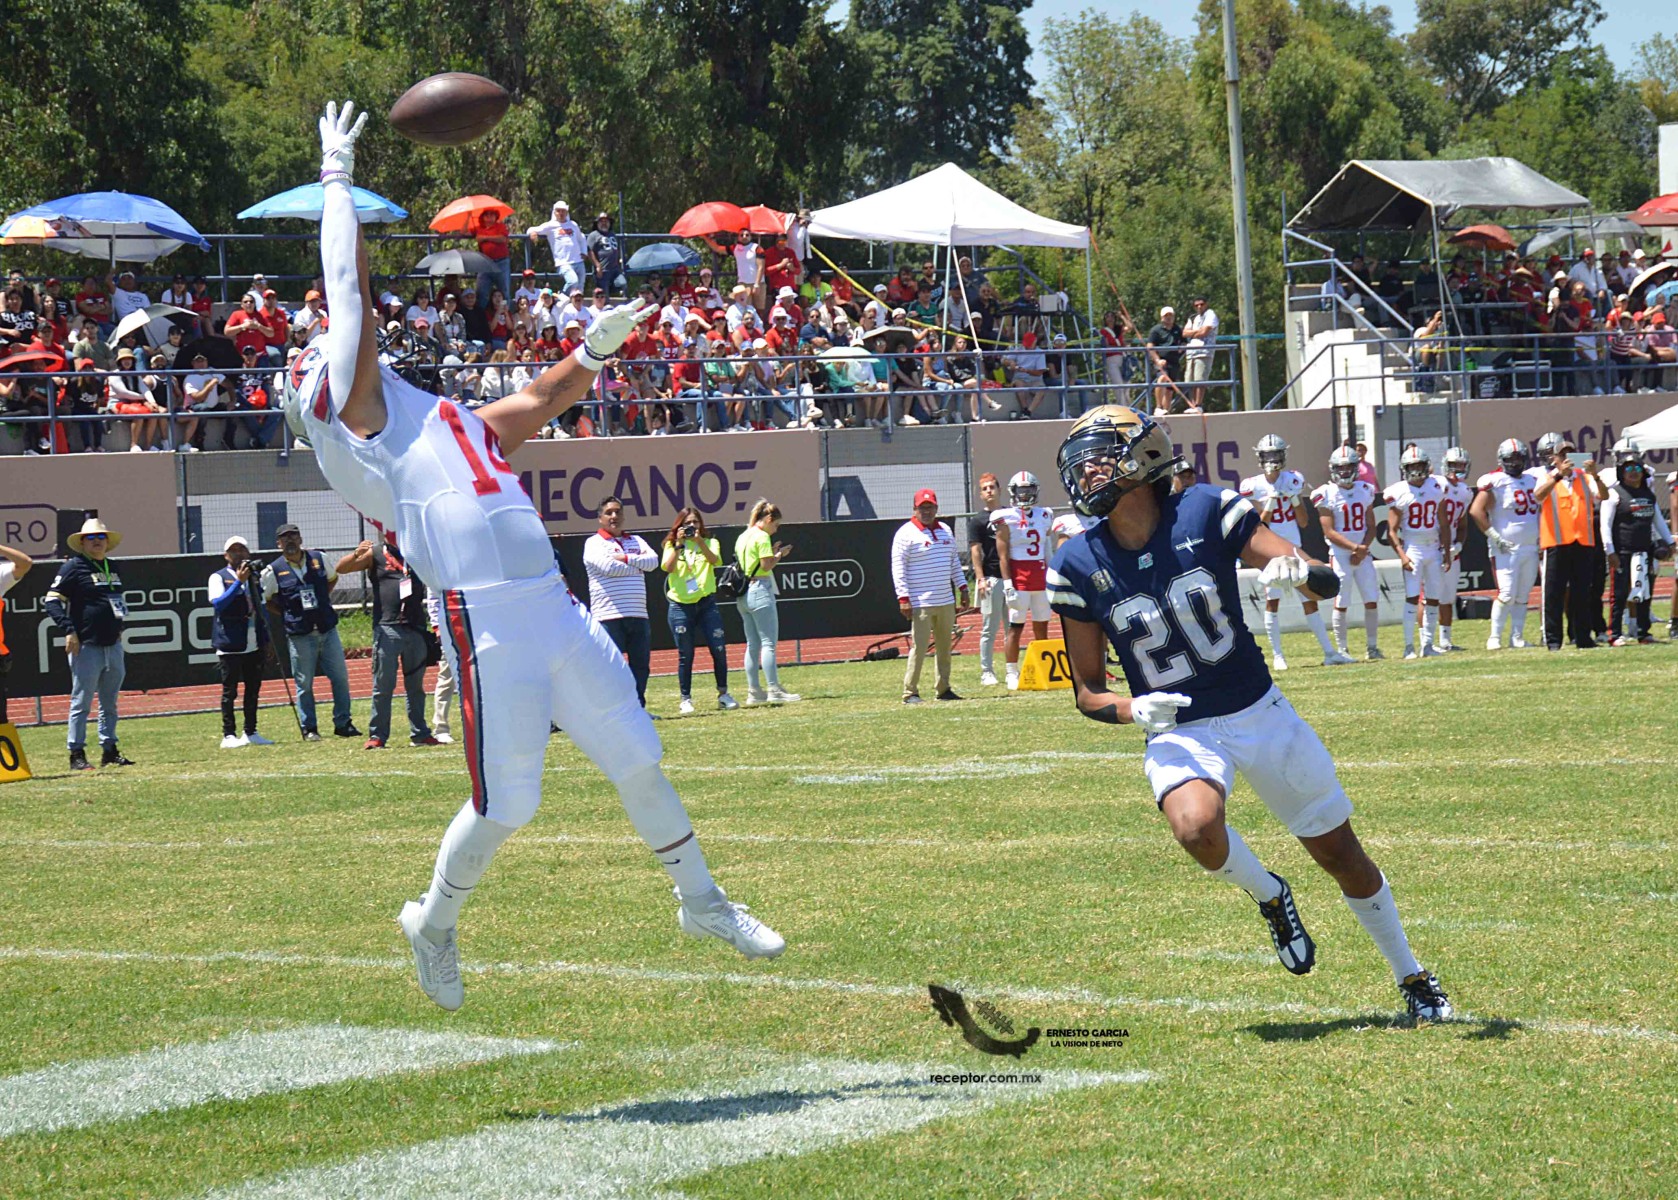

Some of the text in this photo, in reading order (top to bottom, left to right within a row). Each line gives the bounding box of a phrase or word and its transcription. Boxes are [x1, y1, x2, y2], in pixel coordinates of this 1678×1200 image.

[1342, 502, 1364, 531] 18
[1408, 501, 1436, 528] 80
[1026, 529, 1041, 556] 3
[782, 570, 853, 590] NEGRO
[1110, 566, 1236, 690] 20
